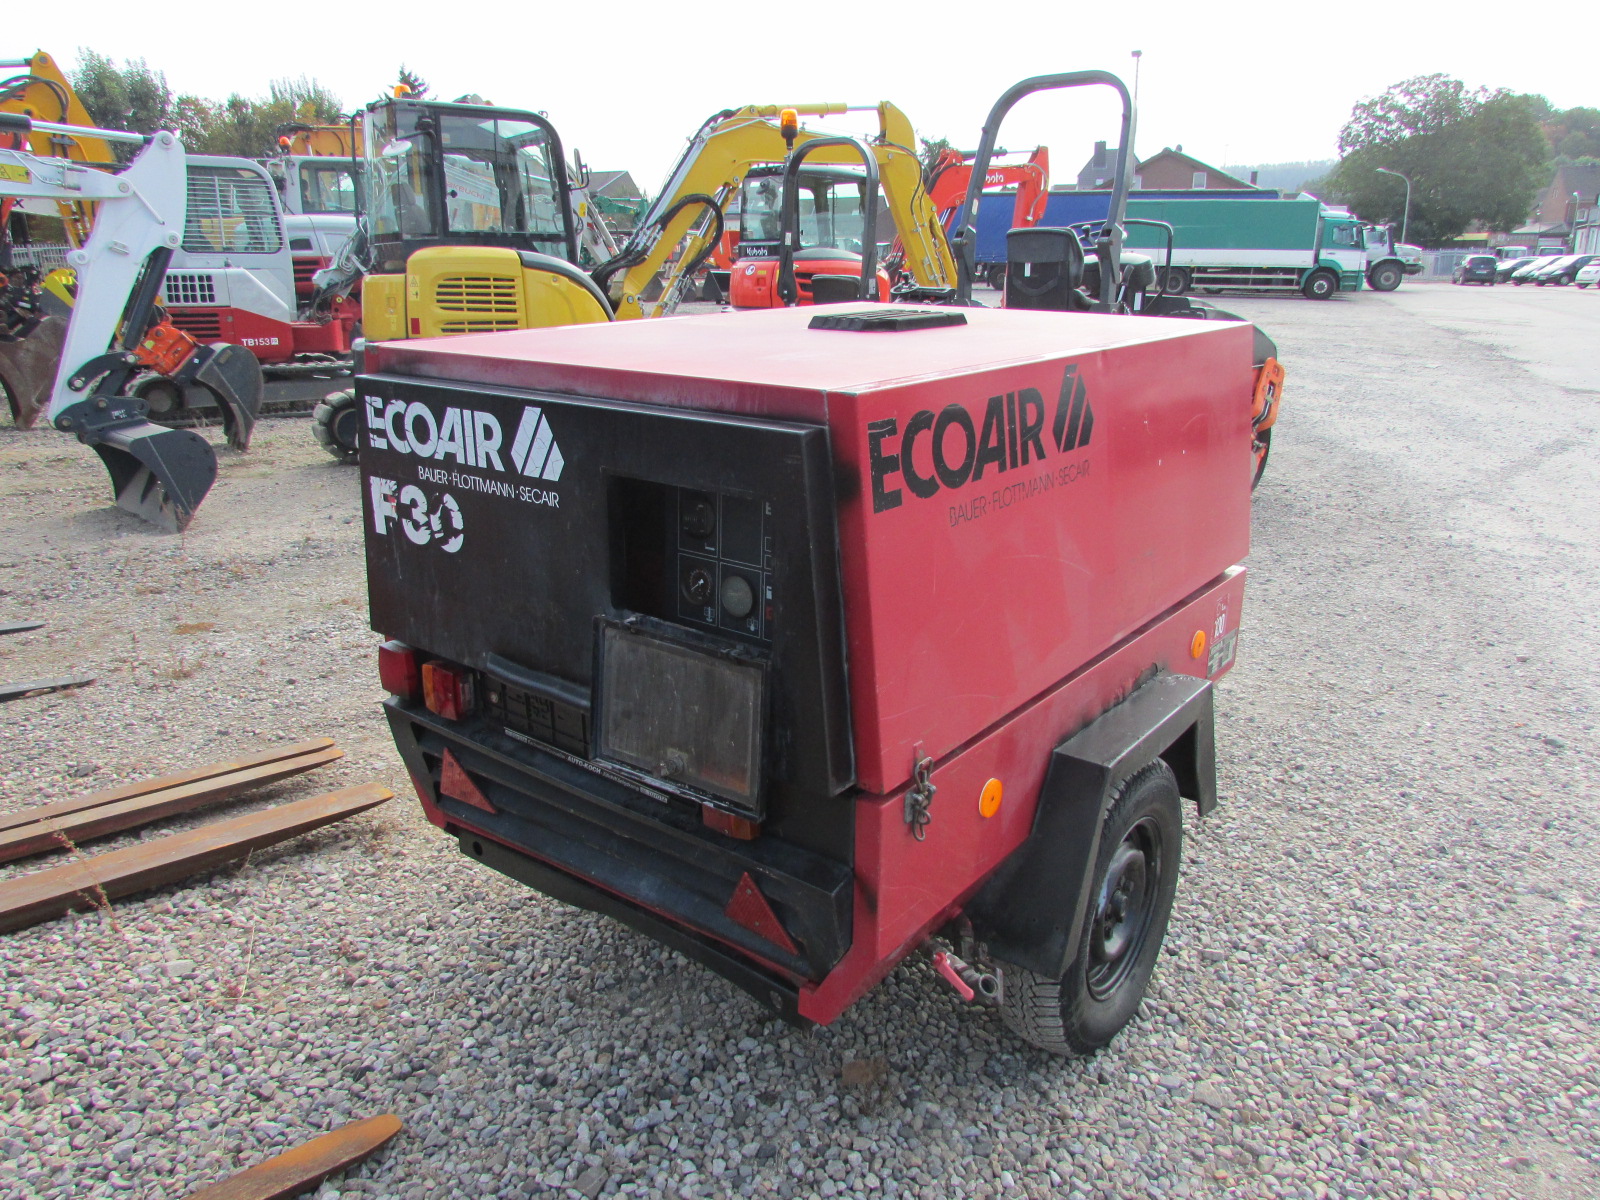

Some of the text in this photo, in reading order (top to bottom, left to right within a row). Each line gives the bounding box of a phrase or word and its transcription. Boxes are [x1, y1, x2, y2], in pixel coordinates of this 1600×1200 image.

[746, 247, 768, 256] Kubota
[241, 338, 270, 347] TB153
[365, 395, 506, 472] ECOAIR
[867, 387, 1047, 514] ECOAIR
[370, 475, 465, 553] F30
